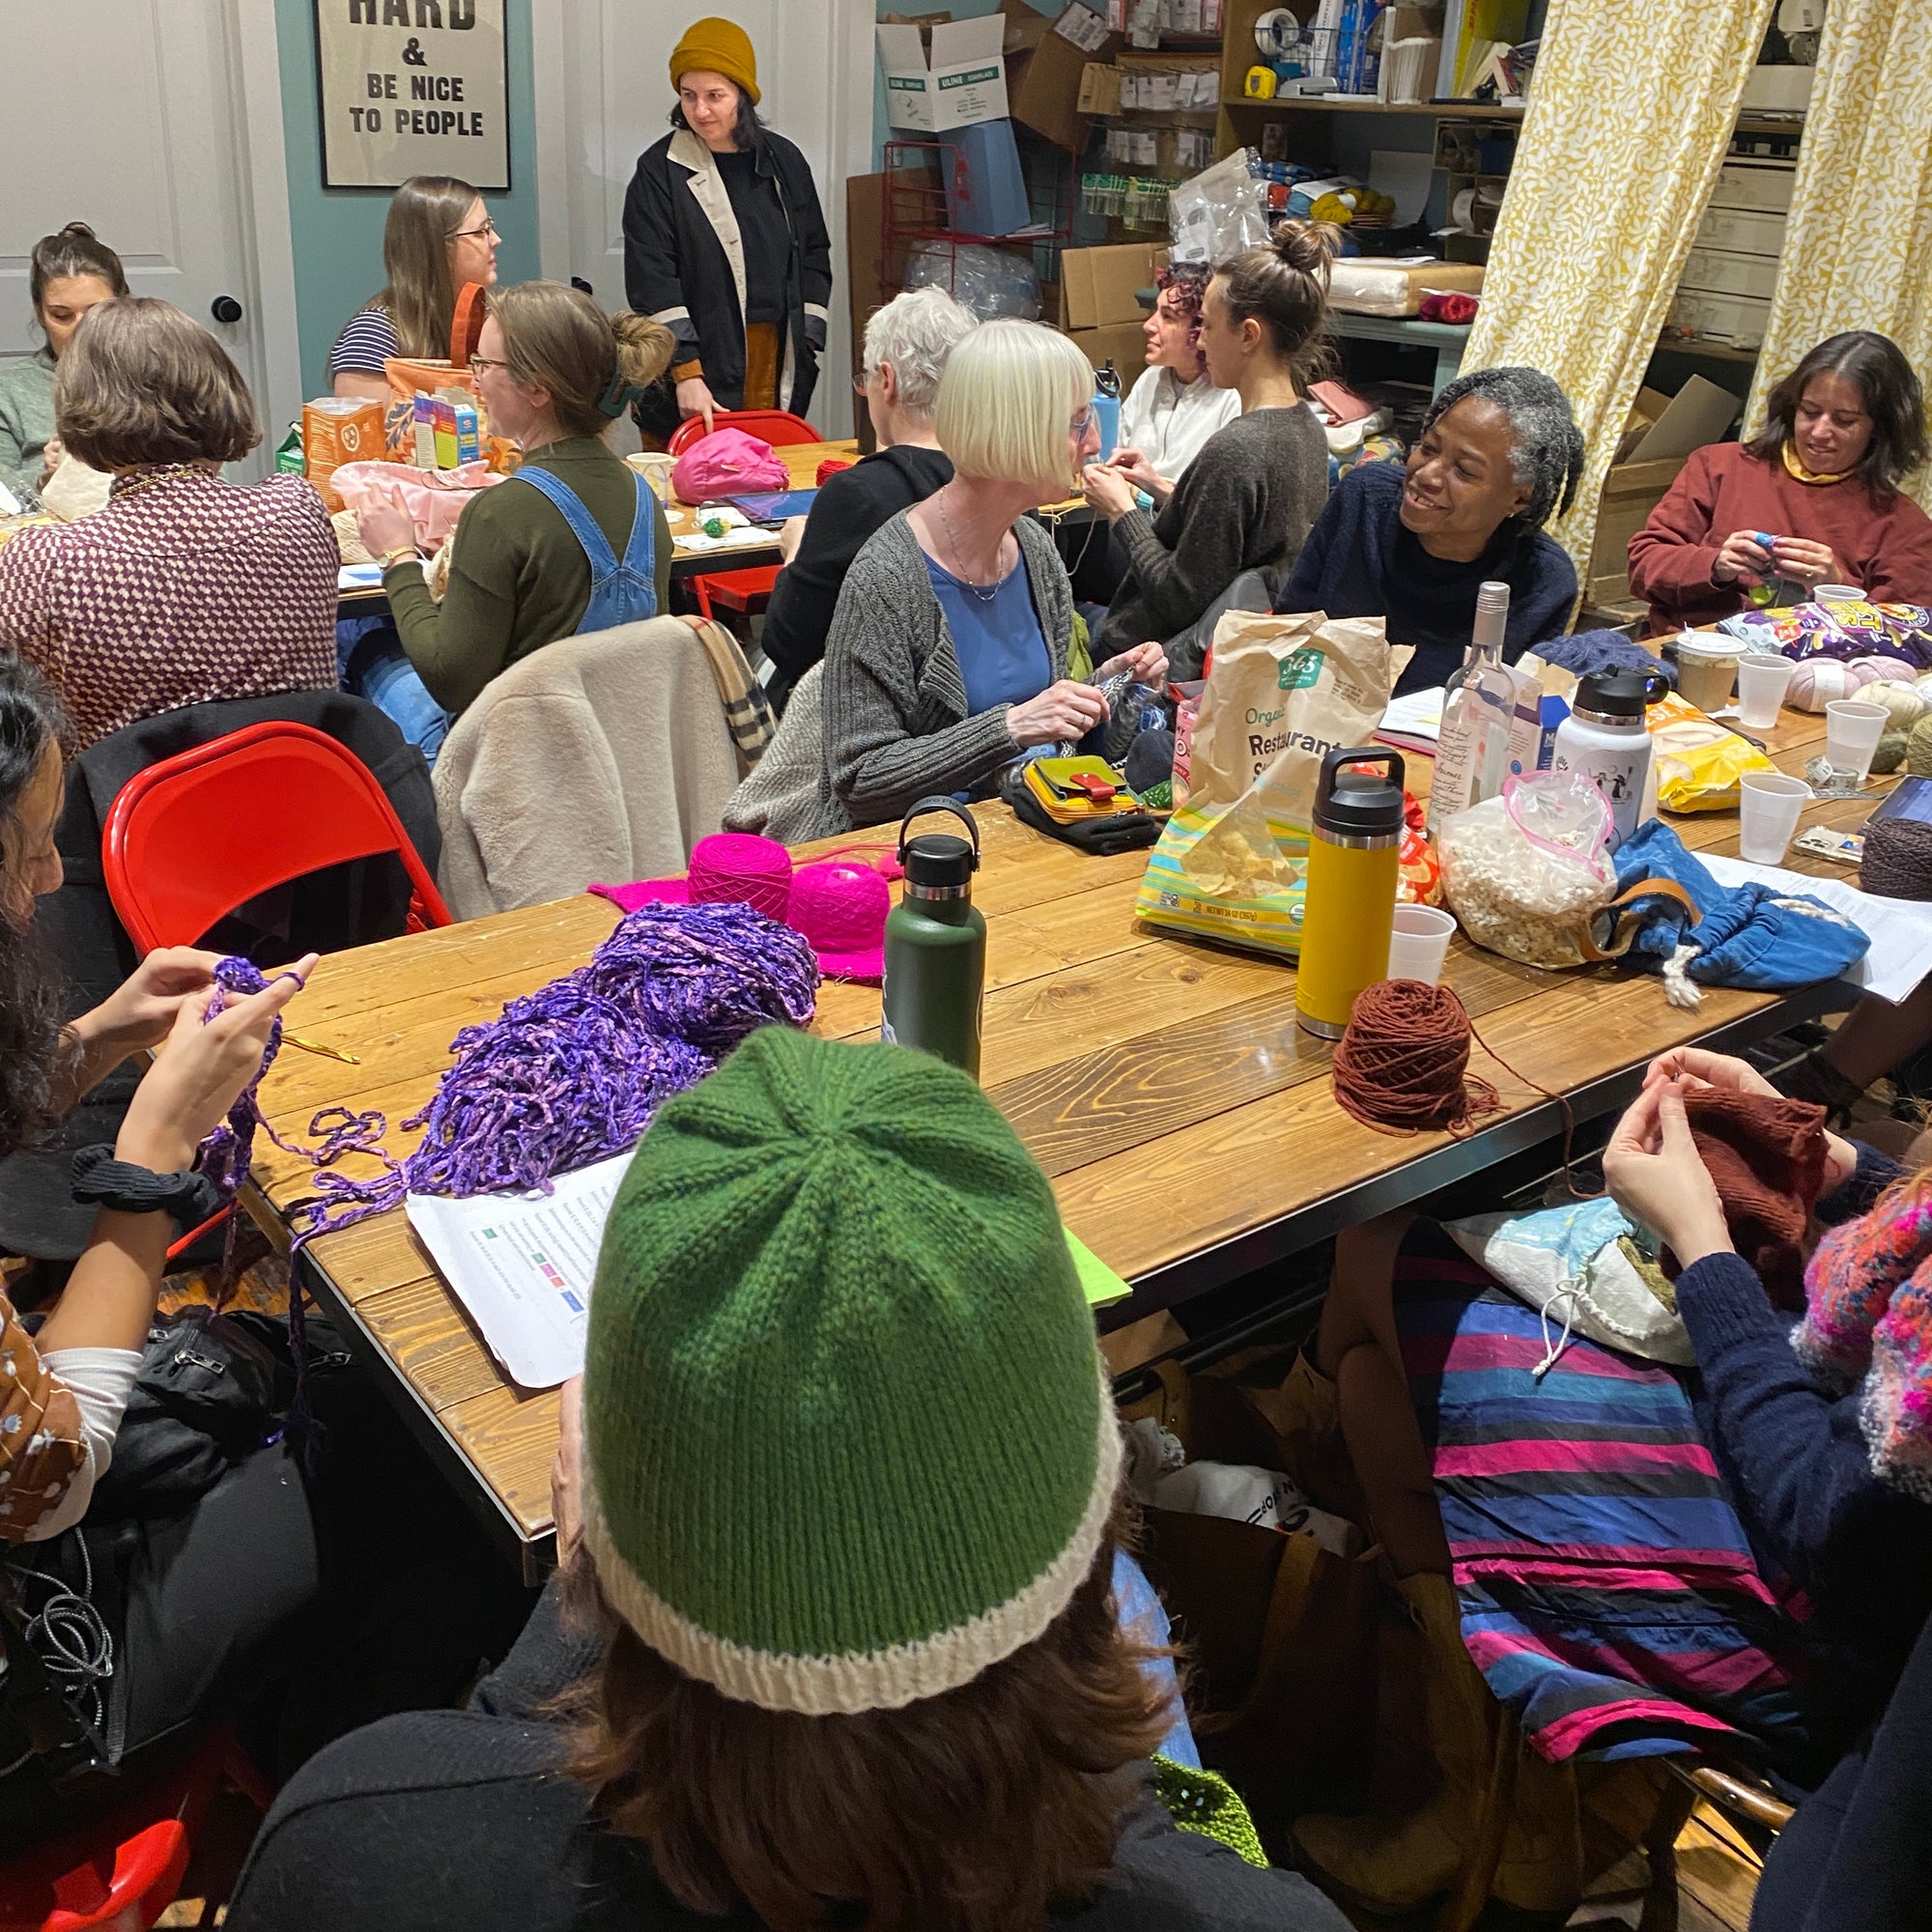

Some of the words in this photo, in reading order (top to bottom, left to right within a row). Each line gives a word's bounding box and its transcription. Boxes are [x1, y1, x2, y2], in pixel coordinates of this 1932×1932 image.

[402, 37, 428, 67] &
[367, 72, 398, 99] BE
[412, 75, 464, 101] NICE
[941, 75, 963, 87] ULINE
[349, 106, 382, 132] TO
[395, 108, 483, 136] PEOPLE
[1283, 655, 1318, 675] 365
